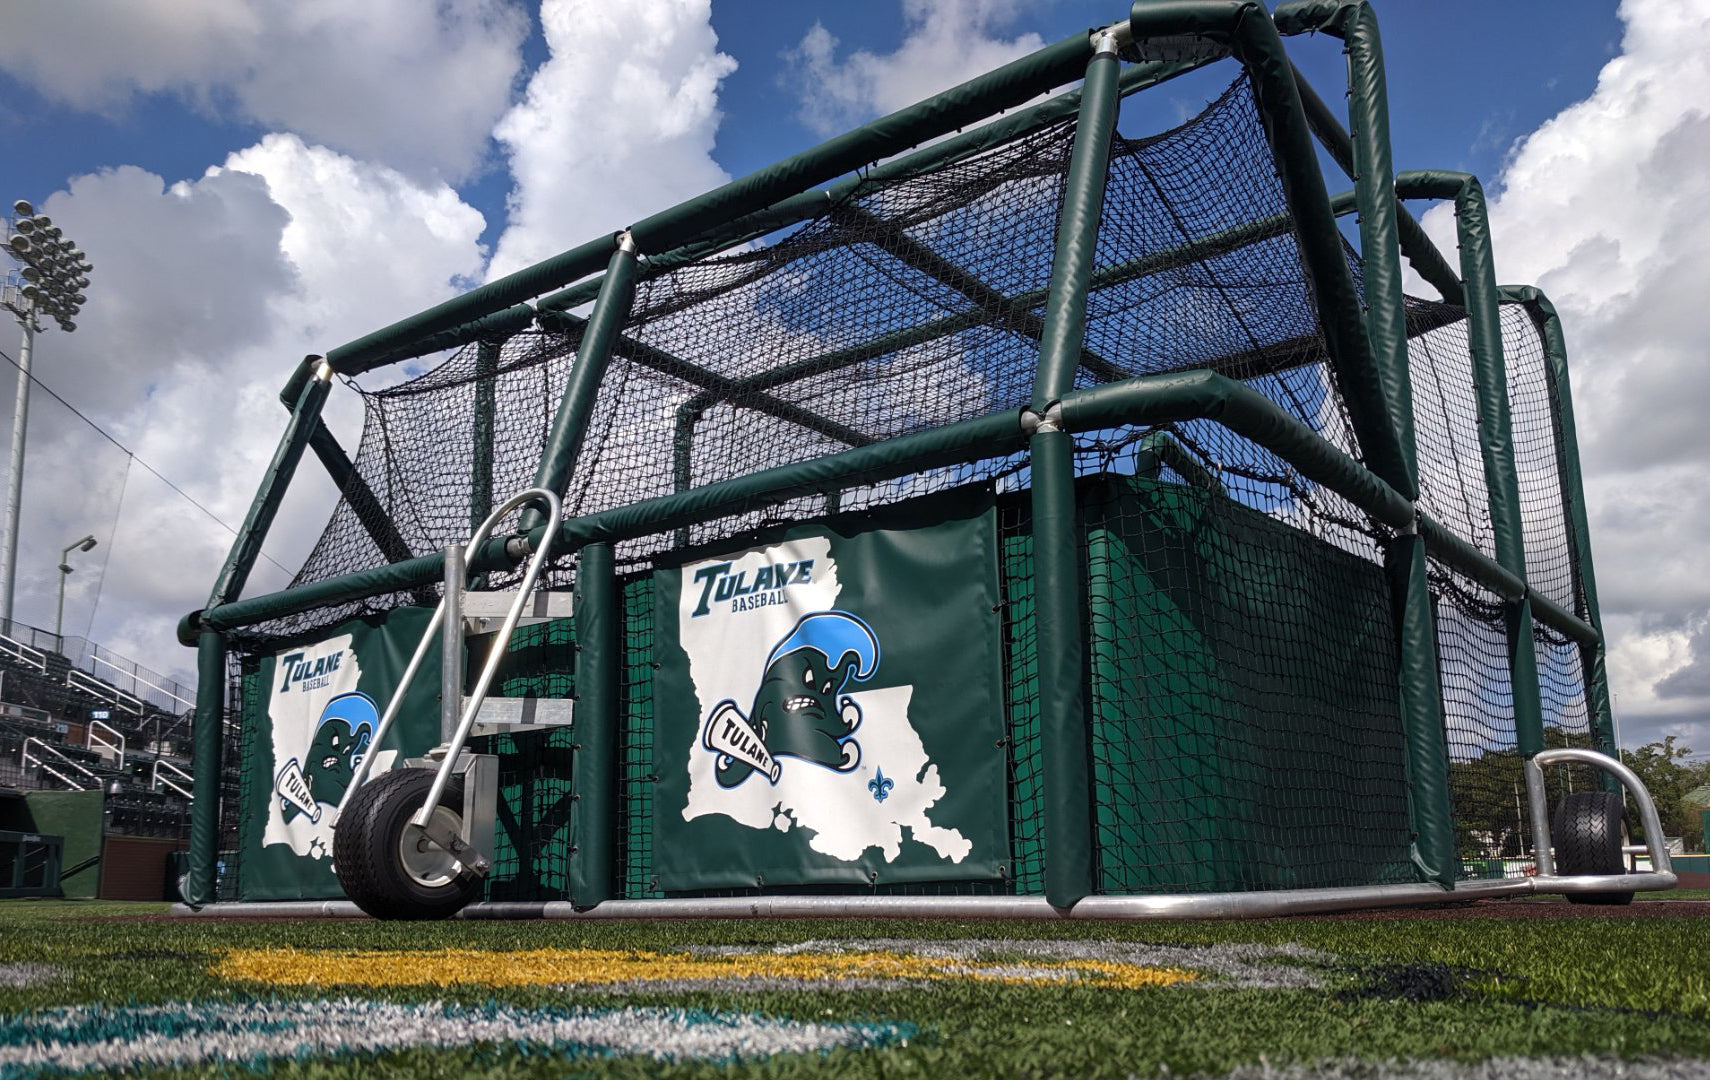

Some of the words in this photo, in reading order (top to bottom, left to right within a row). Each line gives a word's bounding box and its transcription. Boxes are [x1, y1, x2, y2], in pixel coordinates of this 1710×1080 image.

[691, 559, 815, 618] TULANE
[732, 589, 789, 613] BASEBALL
[281, 651, 344, 693] TULANE
[302, 675, 330, 692] BASEBALL
[721, 717, 769, 768] TULANE
[285, 772, 313, 811] TULANE
